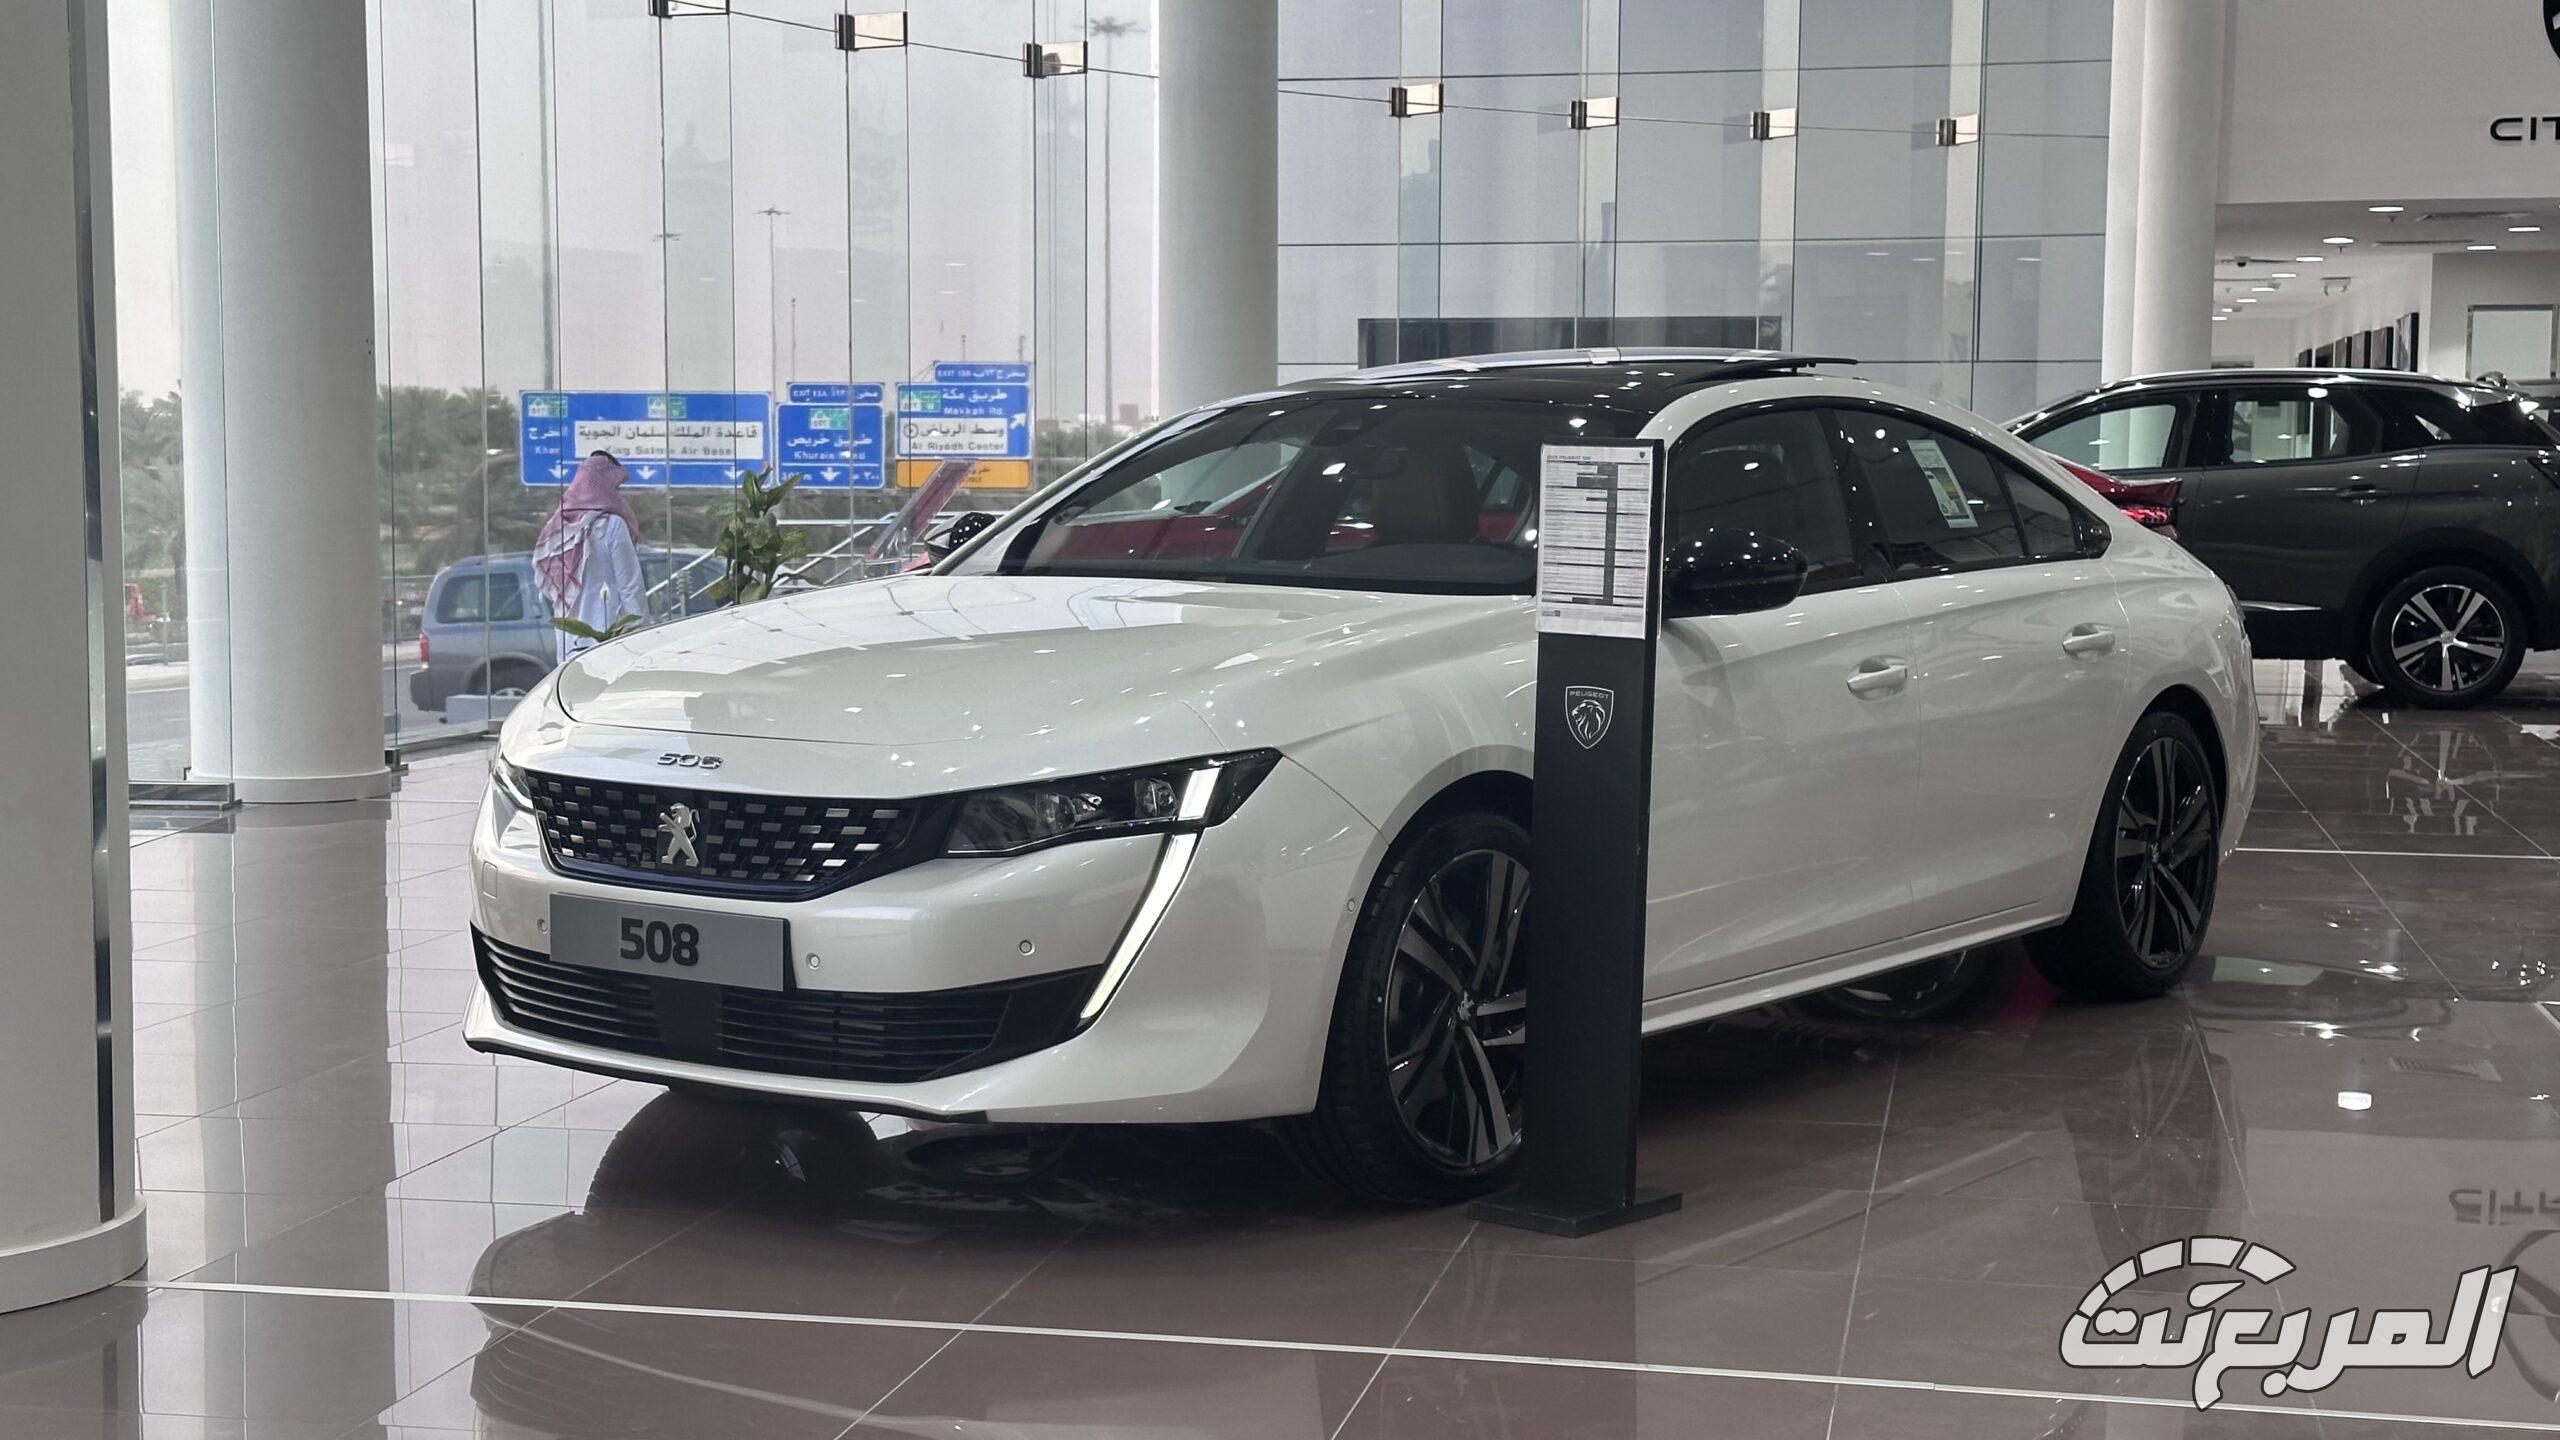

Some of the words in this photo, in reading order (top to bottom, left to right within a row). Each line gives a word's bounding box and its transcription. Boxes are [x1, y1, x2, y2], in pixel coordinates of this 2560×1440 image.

[942, 388, 965, 400] مكة
[968, 389, 1008, 403] طريق
[944, 407, 985, 415] Makkah
[579, 425, 621, 440] الجوية
[626, 426, 668, 440] سلمان
[671, 424, 711, 439] الملك
[715, 424, 758, 438] قاعدة
[971, 423, 1005, 437] وسط
[786, 433, 831, 447] خريص
[928, 442, 964, 451] Riyadh
[968, 442, 1004, 450] Center
[635, 446, 675, 456] Salmn
[681, 446, 698, 456] Air
[703, 446, 732, 456] Base
[1569, 690, 1609, 699] PEUGEOT
[657, 753, 723, 769] 508
[620, 917, 699, 967] 508
